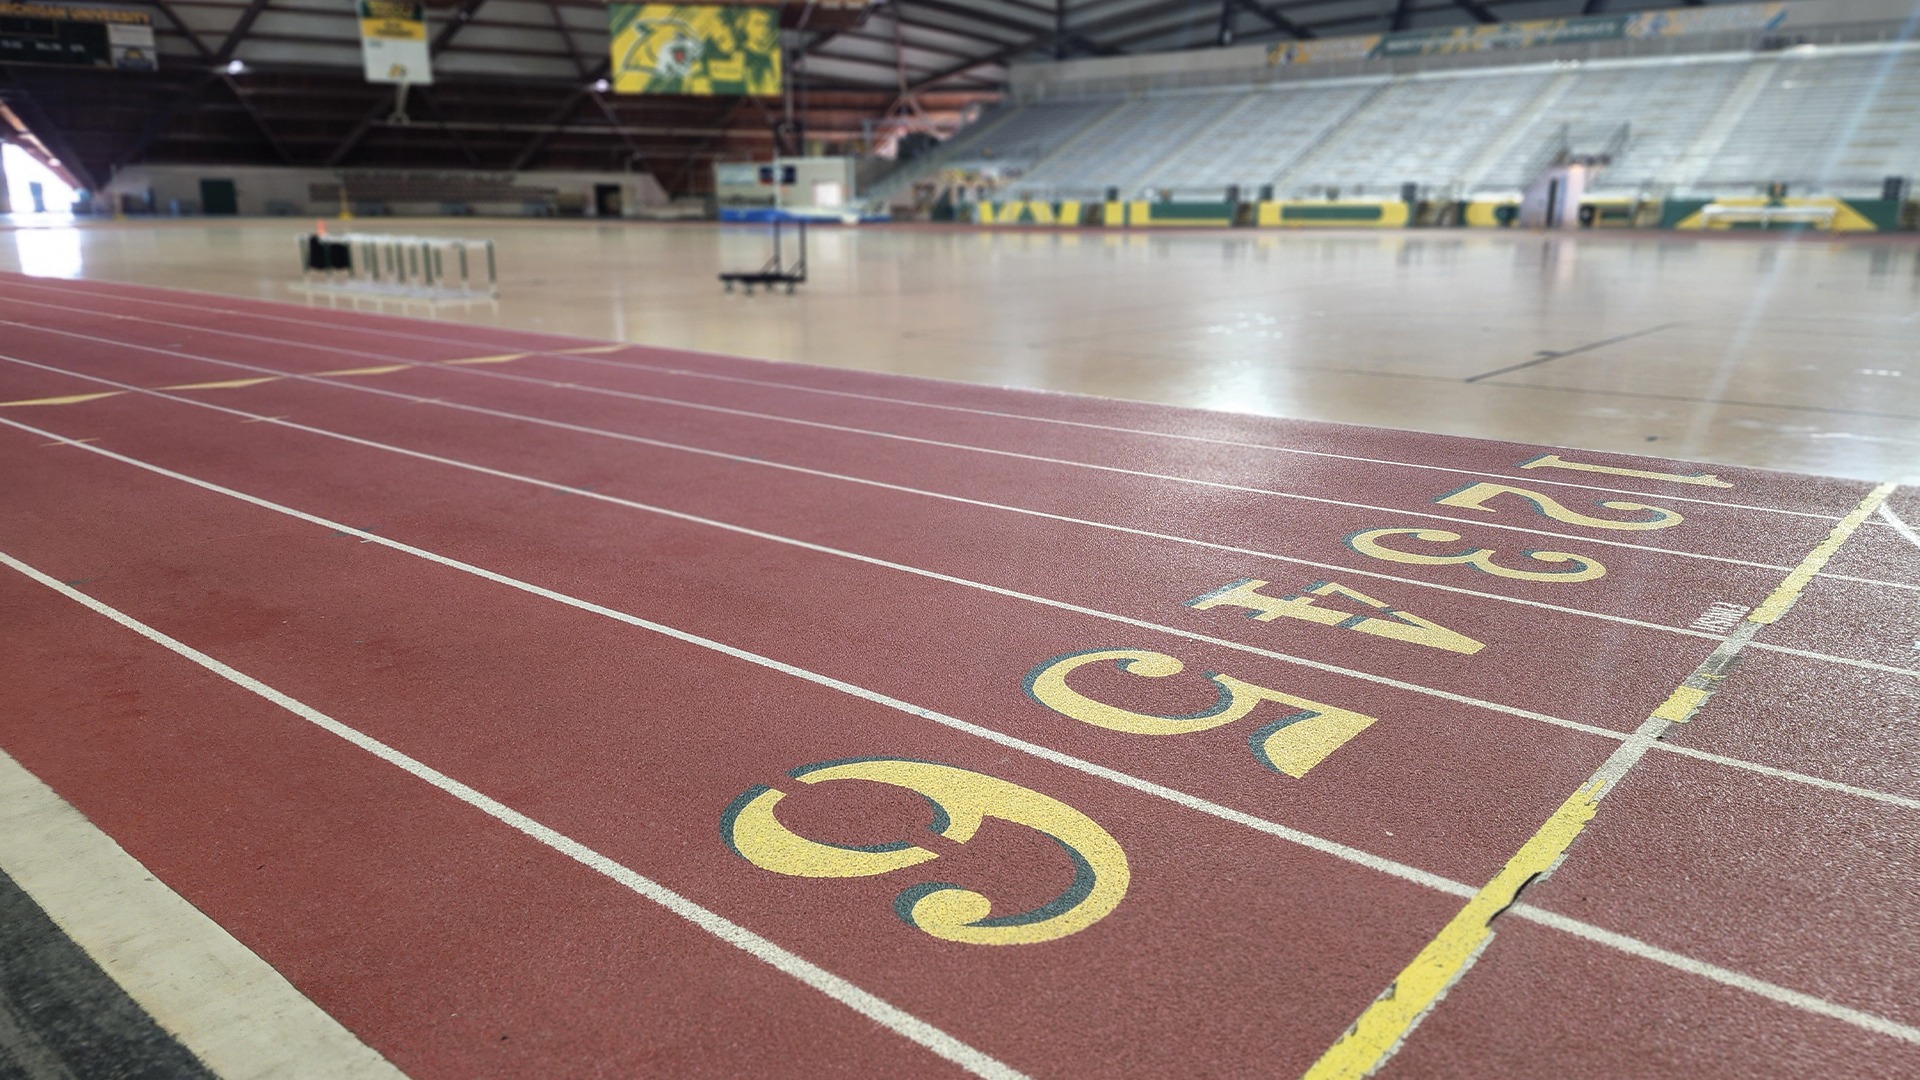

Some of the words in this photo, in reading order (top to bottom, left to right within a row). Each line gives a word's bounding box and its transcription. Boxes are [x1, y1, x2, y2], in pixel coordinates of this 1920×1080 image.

[1513, 454, 1735, 489] 1
[1432, 481, 1684, 531] 2
[1341, 527, 1607, 583] 3
[1183, 577, 1487, 655] 4
[1021, 647, 1378, 779] 5
[719, 756, 1131, 946] 6
